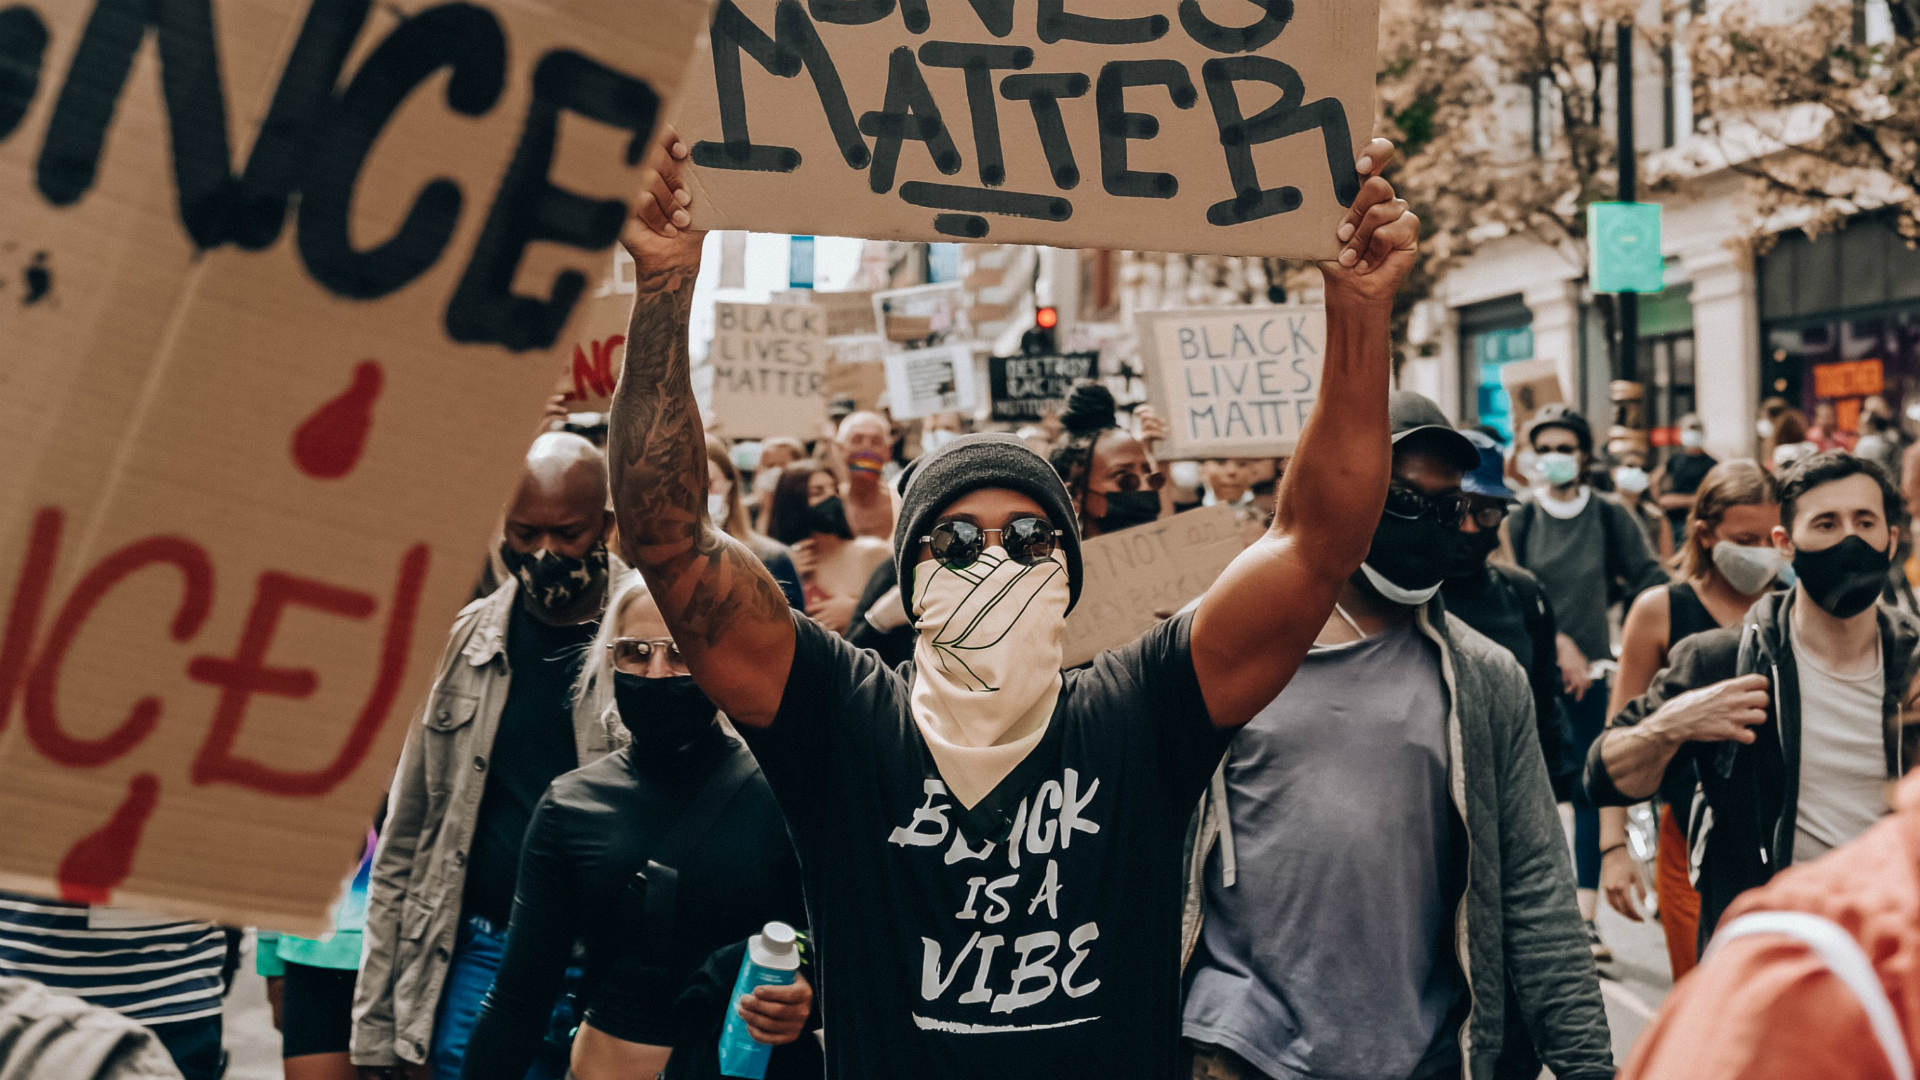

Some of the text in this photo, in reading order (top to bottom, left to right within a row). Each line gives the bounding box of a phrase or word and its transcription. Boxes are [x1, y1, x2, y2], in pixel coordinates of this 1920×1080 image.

[690, 0, 1361, 226] MATTER
[0, 0, 661, 352] NCE
[719, 303, 820, 335] BLACK
[1178, 315, 1317, 360] BLACK
[721, 337, 814, 366] LIVES
[714, 367, 831, 399] MATTER
[1185, 358, 1312, 397] LIVES
[1189, 400, 1316, 438] MATTE
[1100, 527, 1169, 577] NOT
[955, 859, 1063, 924] IS A
[921, 922, 1101, 1014] VIBE
